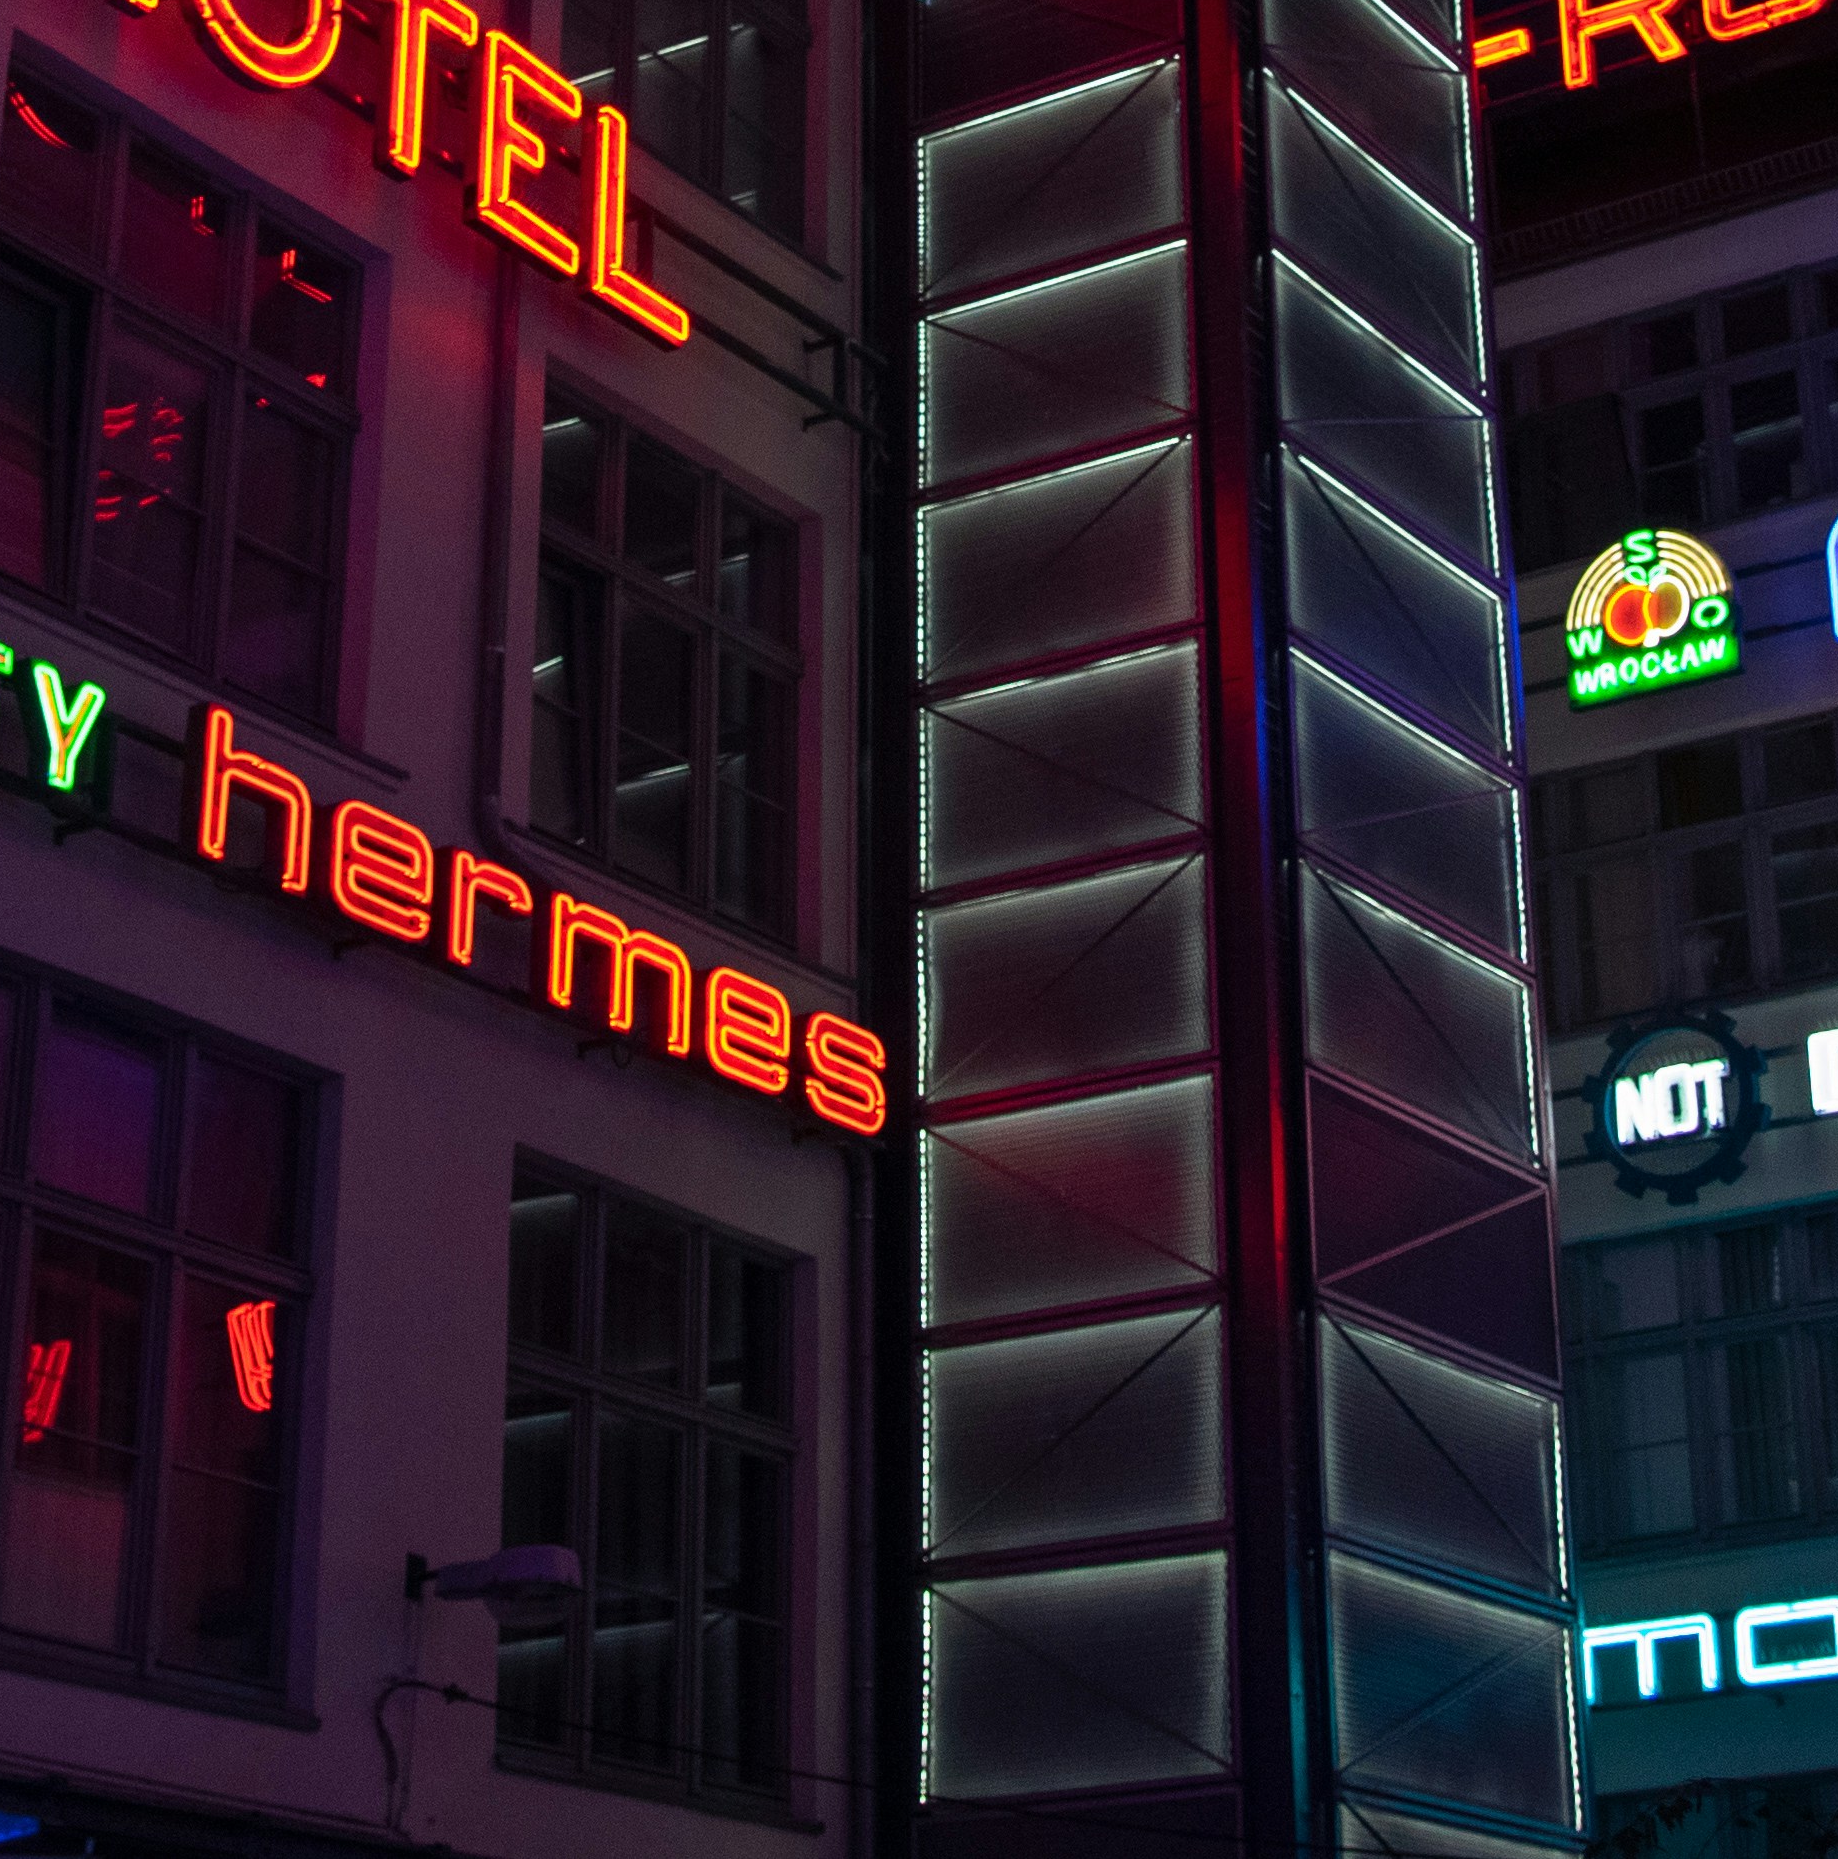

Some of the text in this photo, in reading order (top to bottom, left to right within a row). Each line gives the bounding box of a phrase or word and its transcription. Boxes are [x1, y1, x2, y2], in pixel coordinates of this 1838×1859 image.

[1573, 634, 1728, 696] WROCŁAW
[193, 701, 889, 1137] hermes
[1613, 1055, 1731, 1146] NOT
